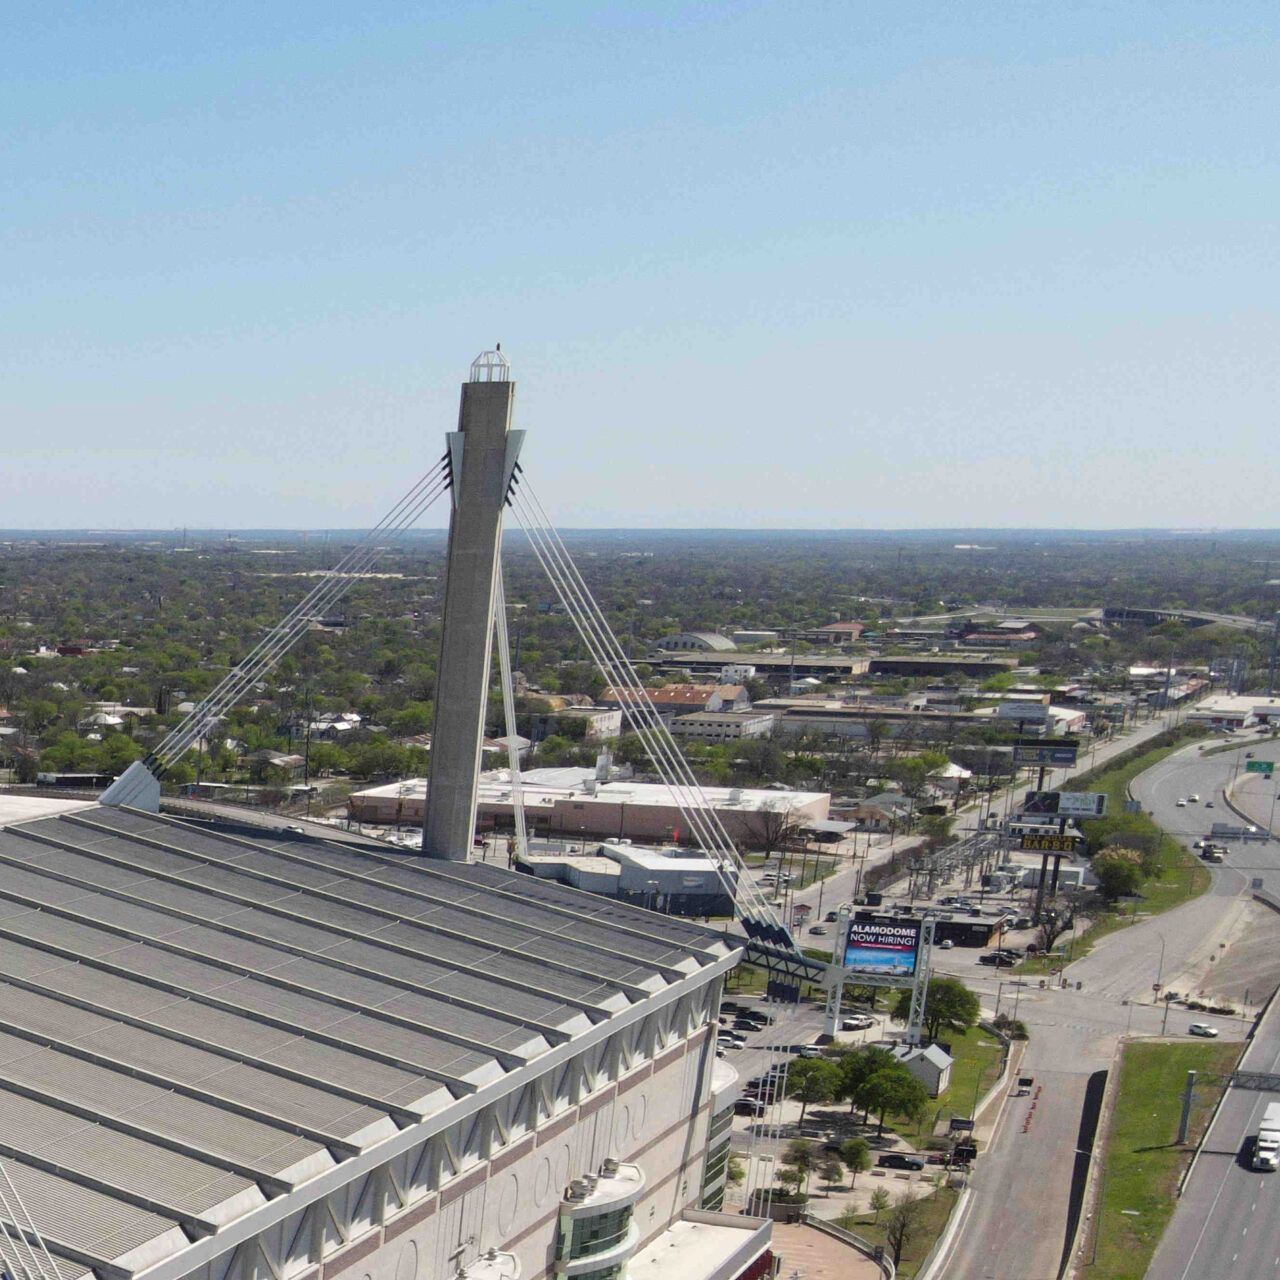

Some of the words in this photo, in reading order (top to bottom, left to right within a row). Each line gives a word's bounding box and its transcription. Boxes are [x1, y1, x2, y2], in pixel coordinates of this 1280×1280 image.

[851, 924, 917, 937] ALAMODOME
[850, 933, 876, 942] NOW
[878, 935, 916, 946] HIRING!
